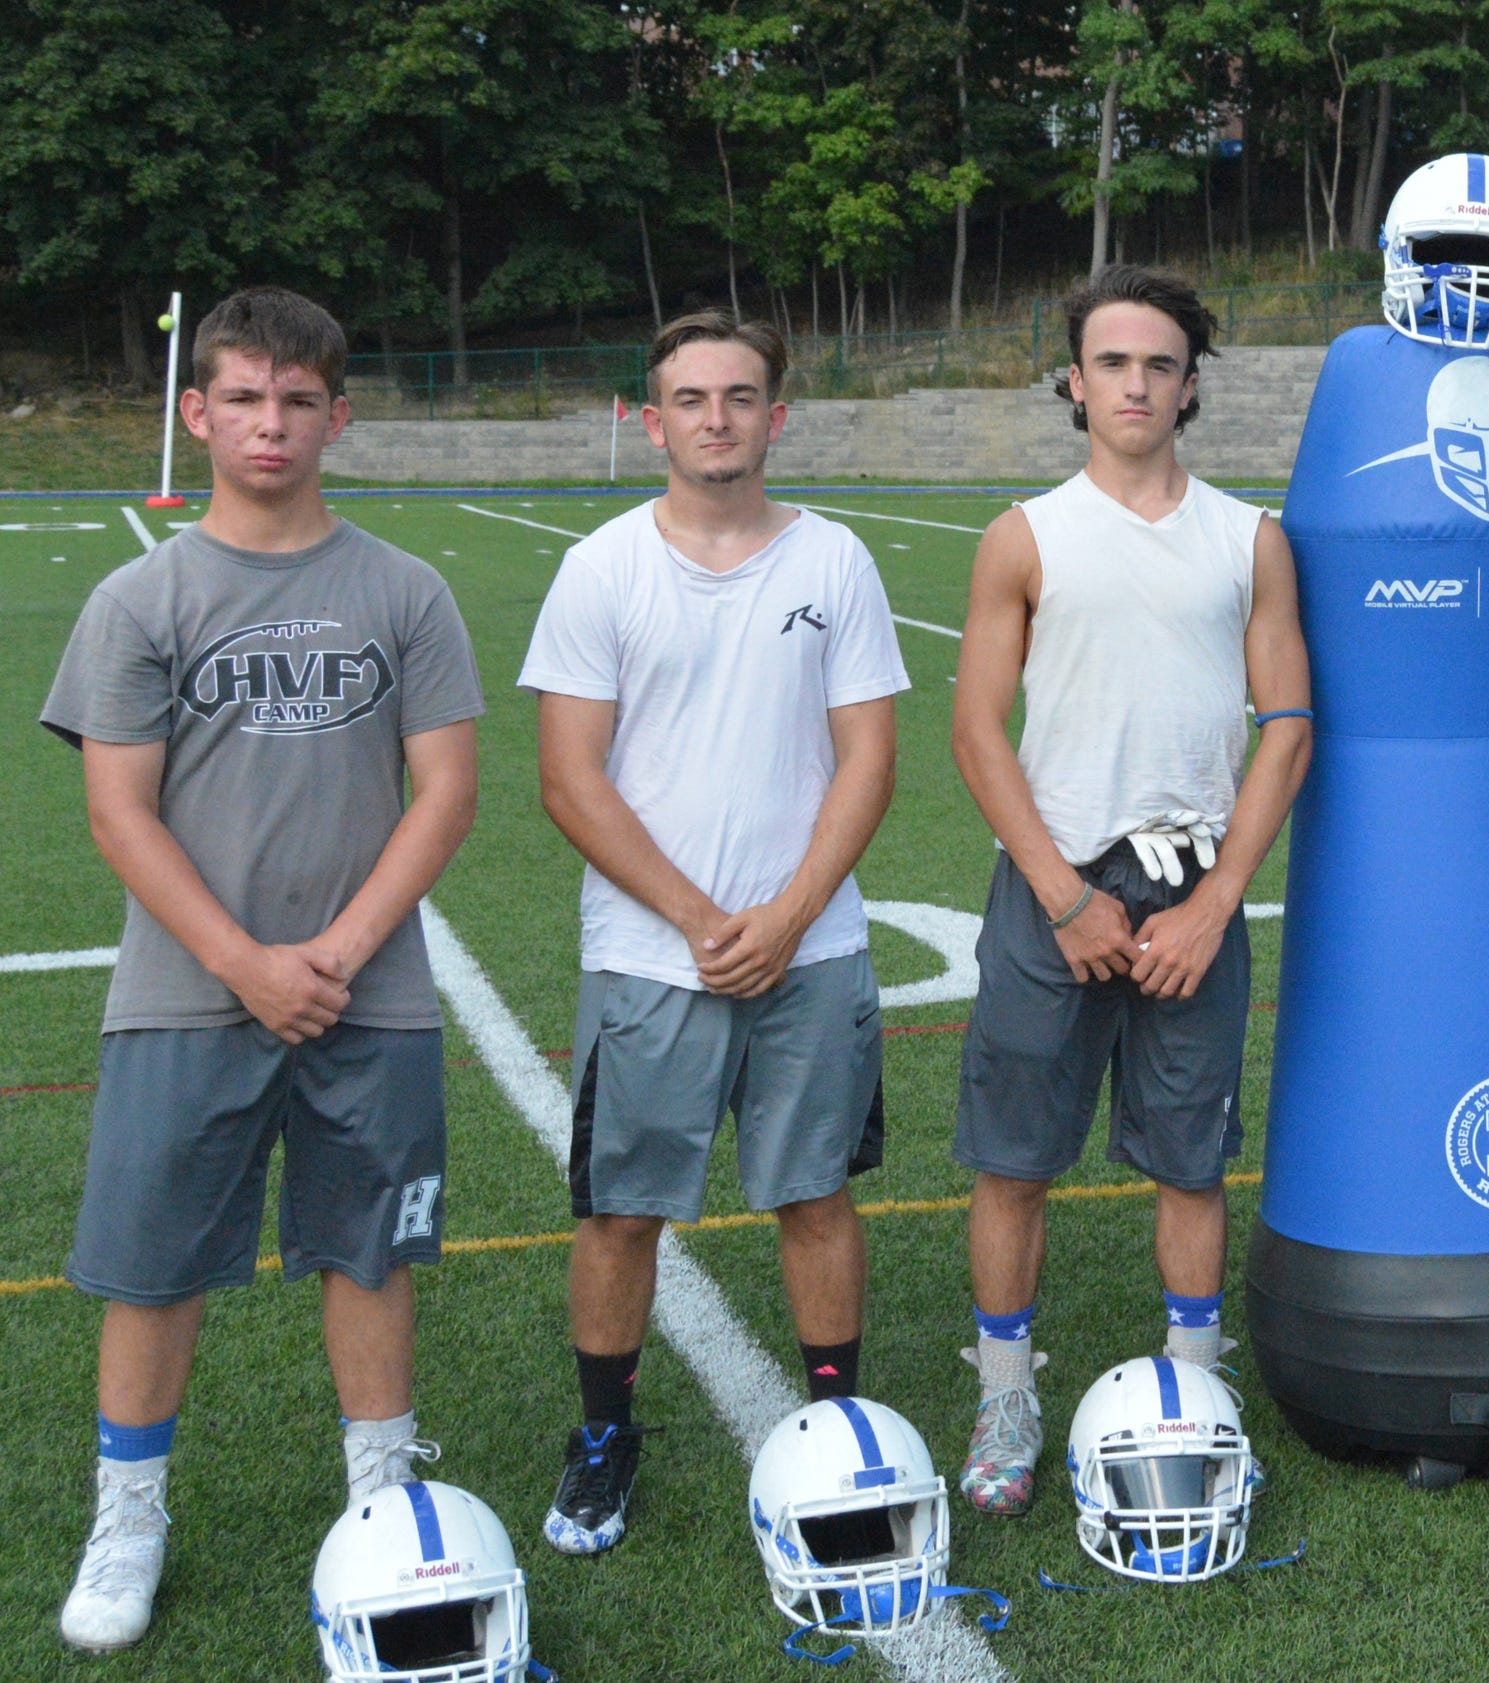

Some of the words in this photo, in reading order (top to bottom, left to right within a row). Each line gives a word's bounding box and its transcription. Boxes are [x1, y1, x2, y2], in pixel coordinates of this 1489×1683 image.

[1364, 580, 1463, 601] MVP
[212, 650, 362, 702] HVF
[253, 703, 330, 723] CAMP
[1457, 1110, 1477, 1168] ROGERS
[392, 1174, 441, 1246] H
[1157, 1422, 1196, 1434] Riddell
[415, 1562, 460, 1579] Riddell
